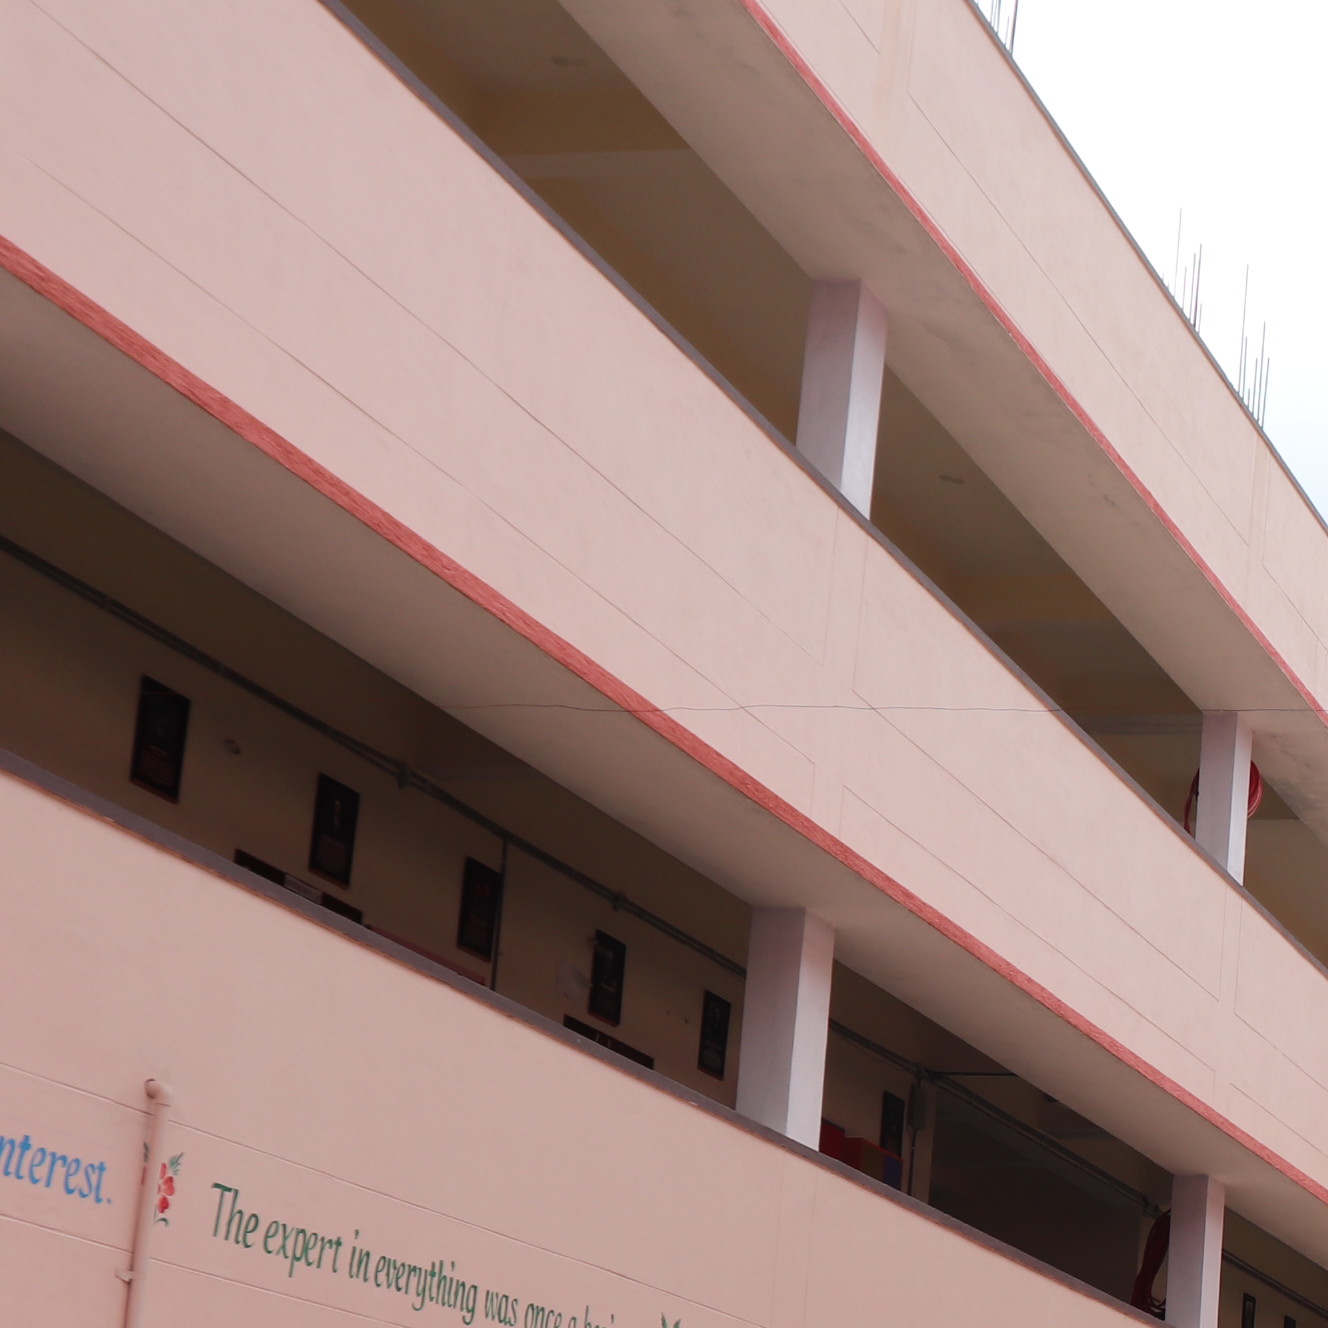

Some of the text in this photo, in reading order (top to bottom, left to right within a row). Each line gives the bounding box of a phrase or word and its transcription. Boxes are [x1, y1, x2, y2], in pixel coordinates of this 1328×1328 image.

[211, 1182, 259, 1249] The
[263, 1218, 342, 1278] expert
[349, 1228, 371, 1282] in
[374, 1254, 478, 1326] everything
[484, 1289, 518, 1327] was
